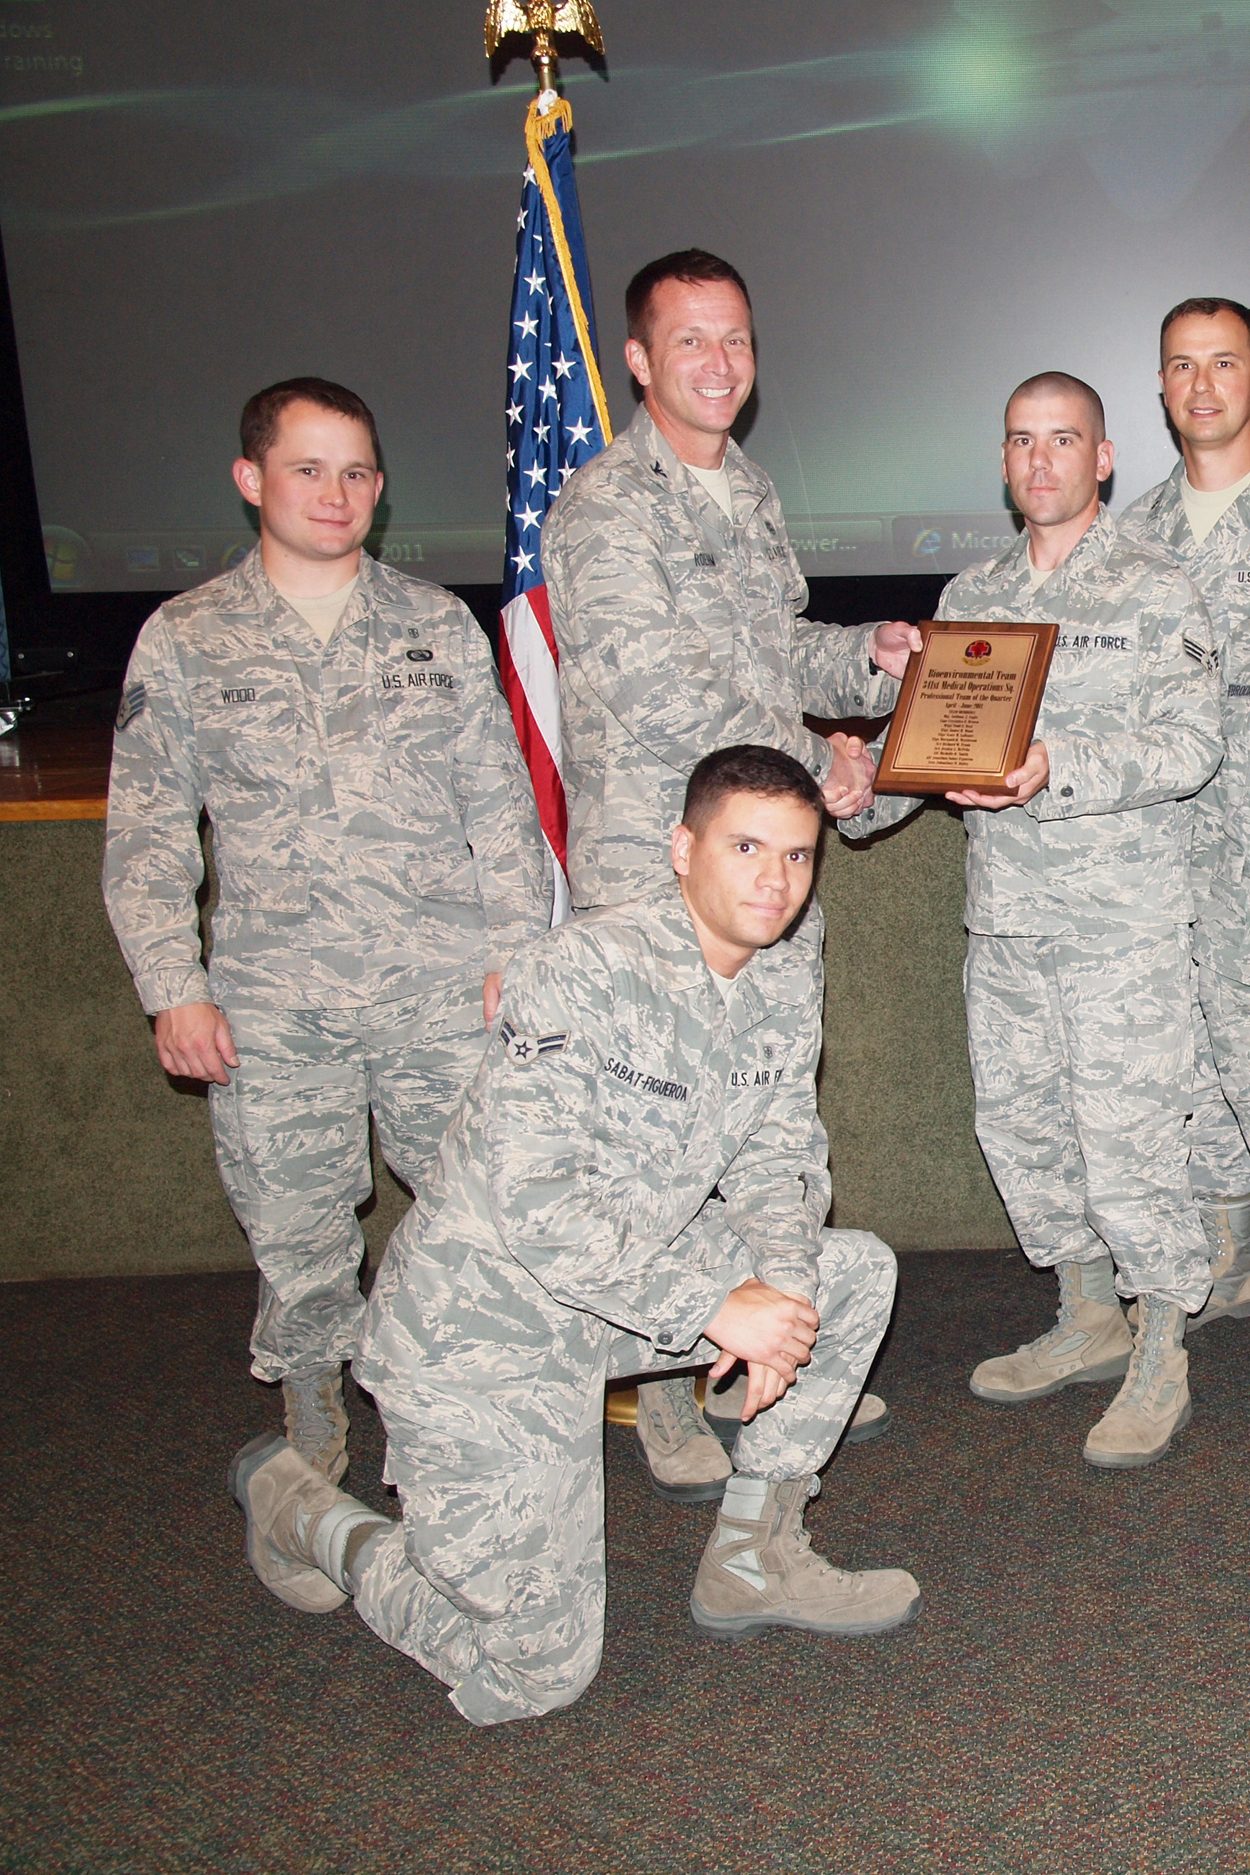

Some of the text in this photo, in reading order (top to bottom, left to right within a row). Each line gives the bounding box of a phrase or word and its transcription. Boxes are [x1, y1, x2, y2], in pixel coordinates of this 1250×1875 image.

[952, 531, 1018, 549] Micro
[1073, 635, 1089, 648] AIR
[1094, 636, 1127, 650] FORCE
[382, 672, 454, 689] U.S. AIR FORCE
[928, 669, 1017, 681] Bioenvironmental Team
[941, 681, 967, 691] Medical
[967, 681, 1004, 693] Operations
[221, 688, 256, 704] WOOD
[920, 692, 955, 700] Professional
[990, 694, 1013, 702] Quarter
[604, 1058, 688, 1101] SABAT-FIGUEROA
[731, 1072, 749, 1086] U.S.
[754, 1071, 770, 1086] AIR
